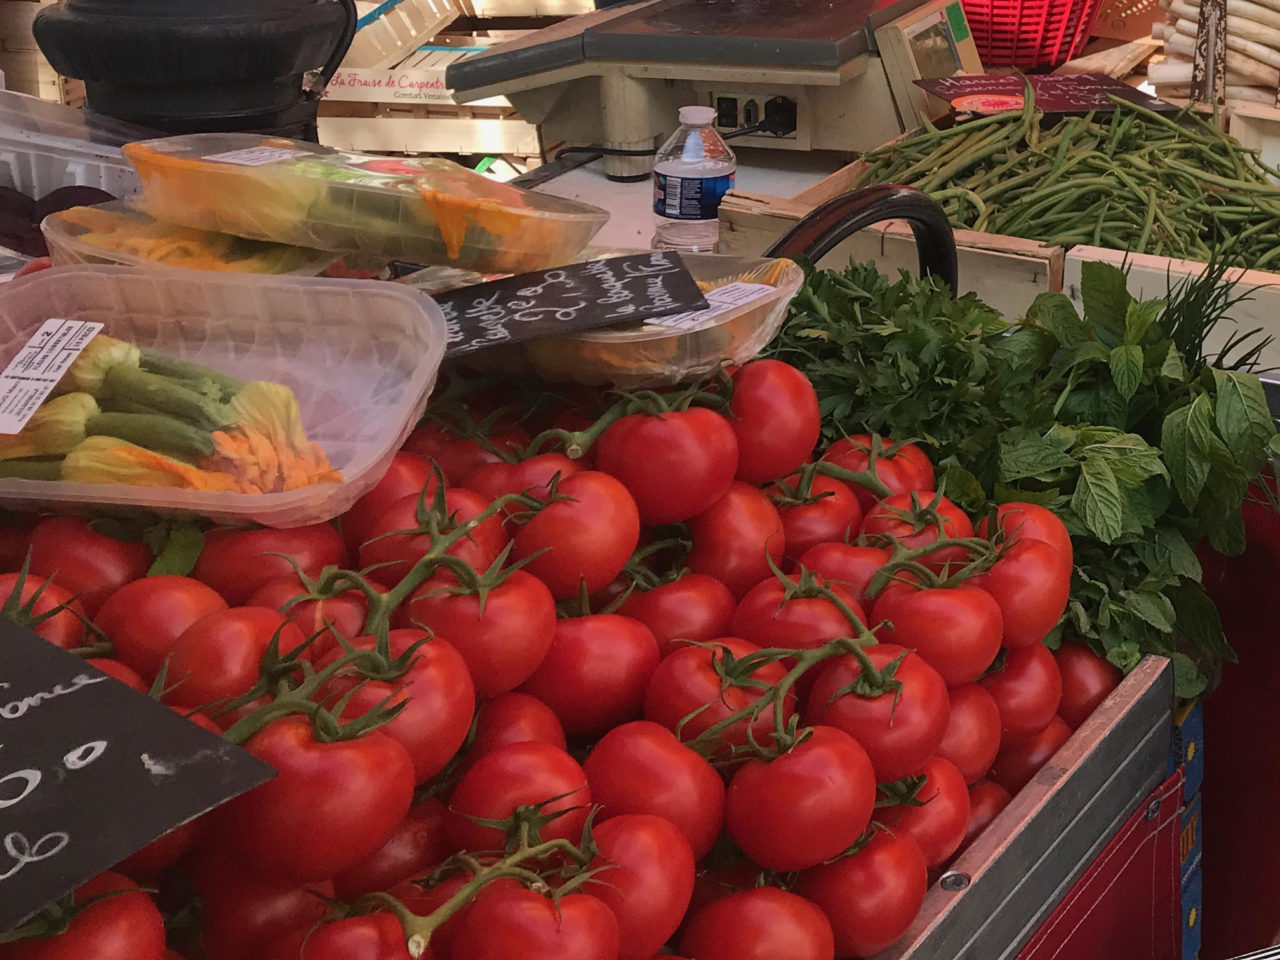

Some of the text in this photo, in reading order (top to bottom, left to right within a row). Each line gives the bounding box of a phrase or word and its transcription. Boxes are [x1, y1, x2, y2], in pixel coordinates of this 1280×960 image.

[331, 72, 445, 91] La Fraise de Carpentr
